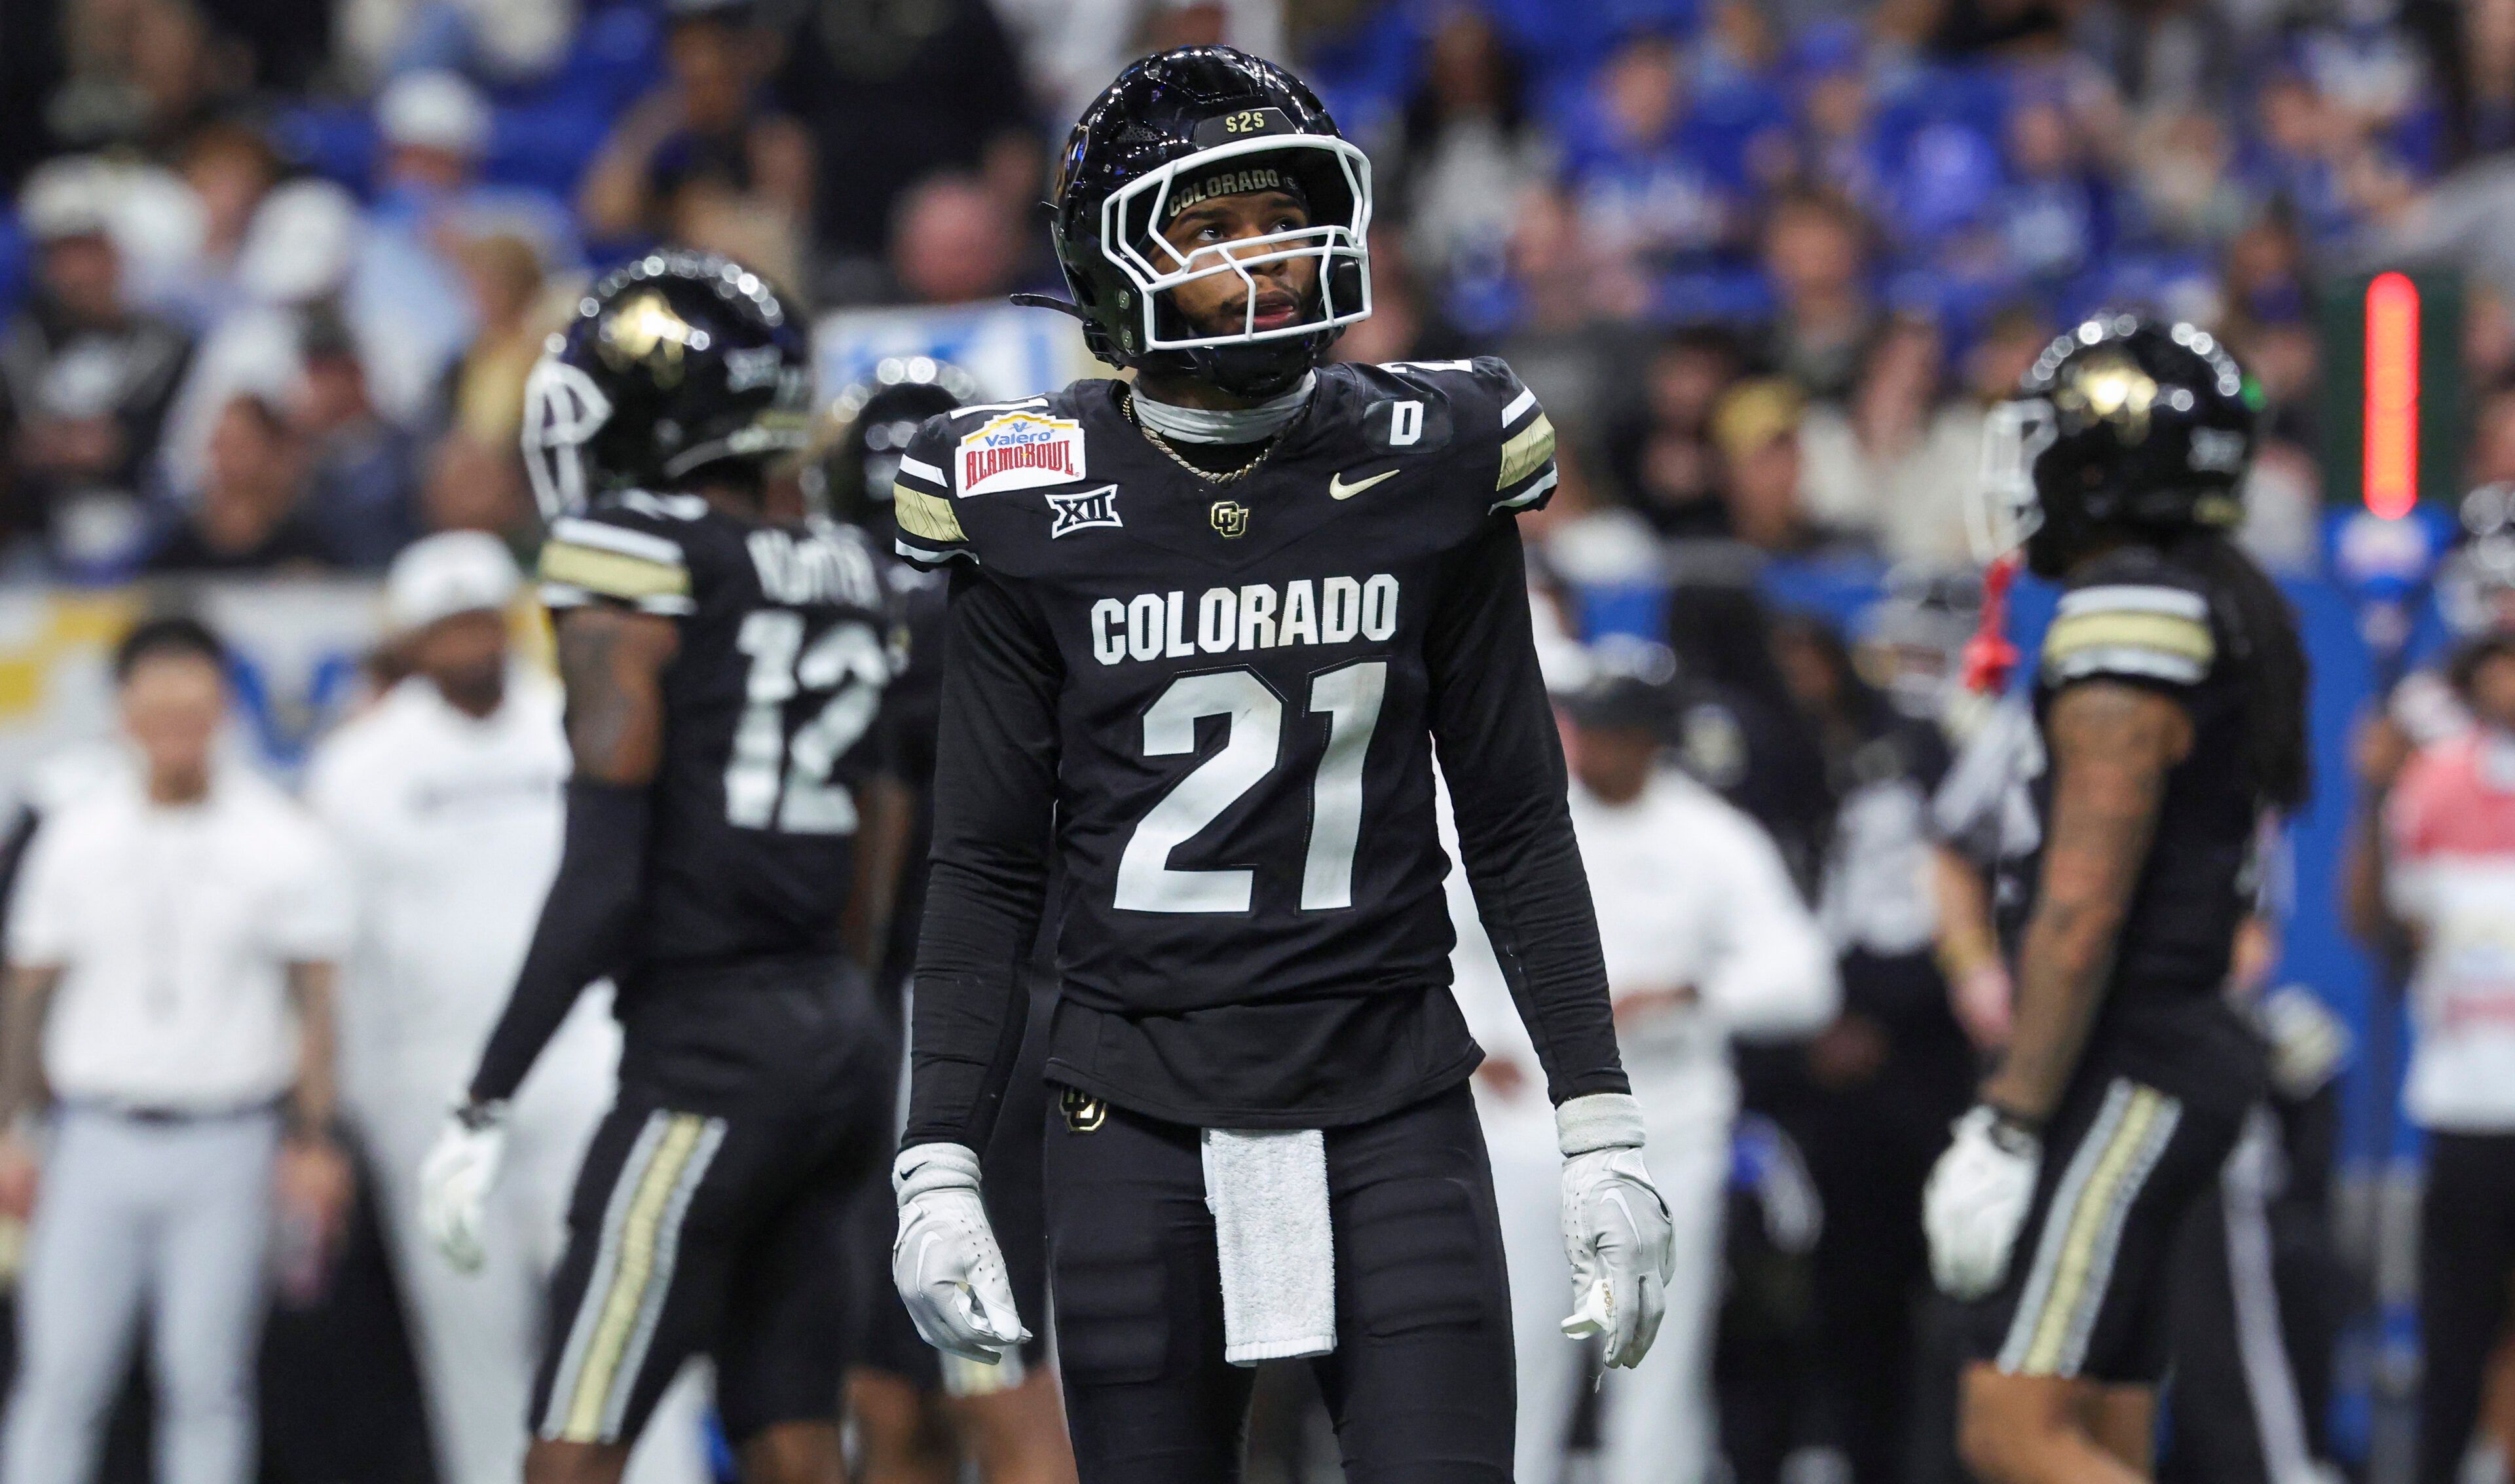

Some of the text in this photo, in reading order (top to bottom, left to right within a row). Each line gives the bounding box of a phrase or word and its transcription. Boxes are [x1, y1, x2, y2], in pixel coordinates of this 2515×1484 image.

[1168, 169, 1280, 217] COLORADO
[985, 432, 1051, 447] Valero
[1389, 400, 1424, 445] D
[1049, 486, 1121, 536] XII
[1091, 574, 1399, 665] COLORADO
[723, 608, 889, 834] 12
[1113, 661, 1387, 913] 21
